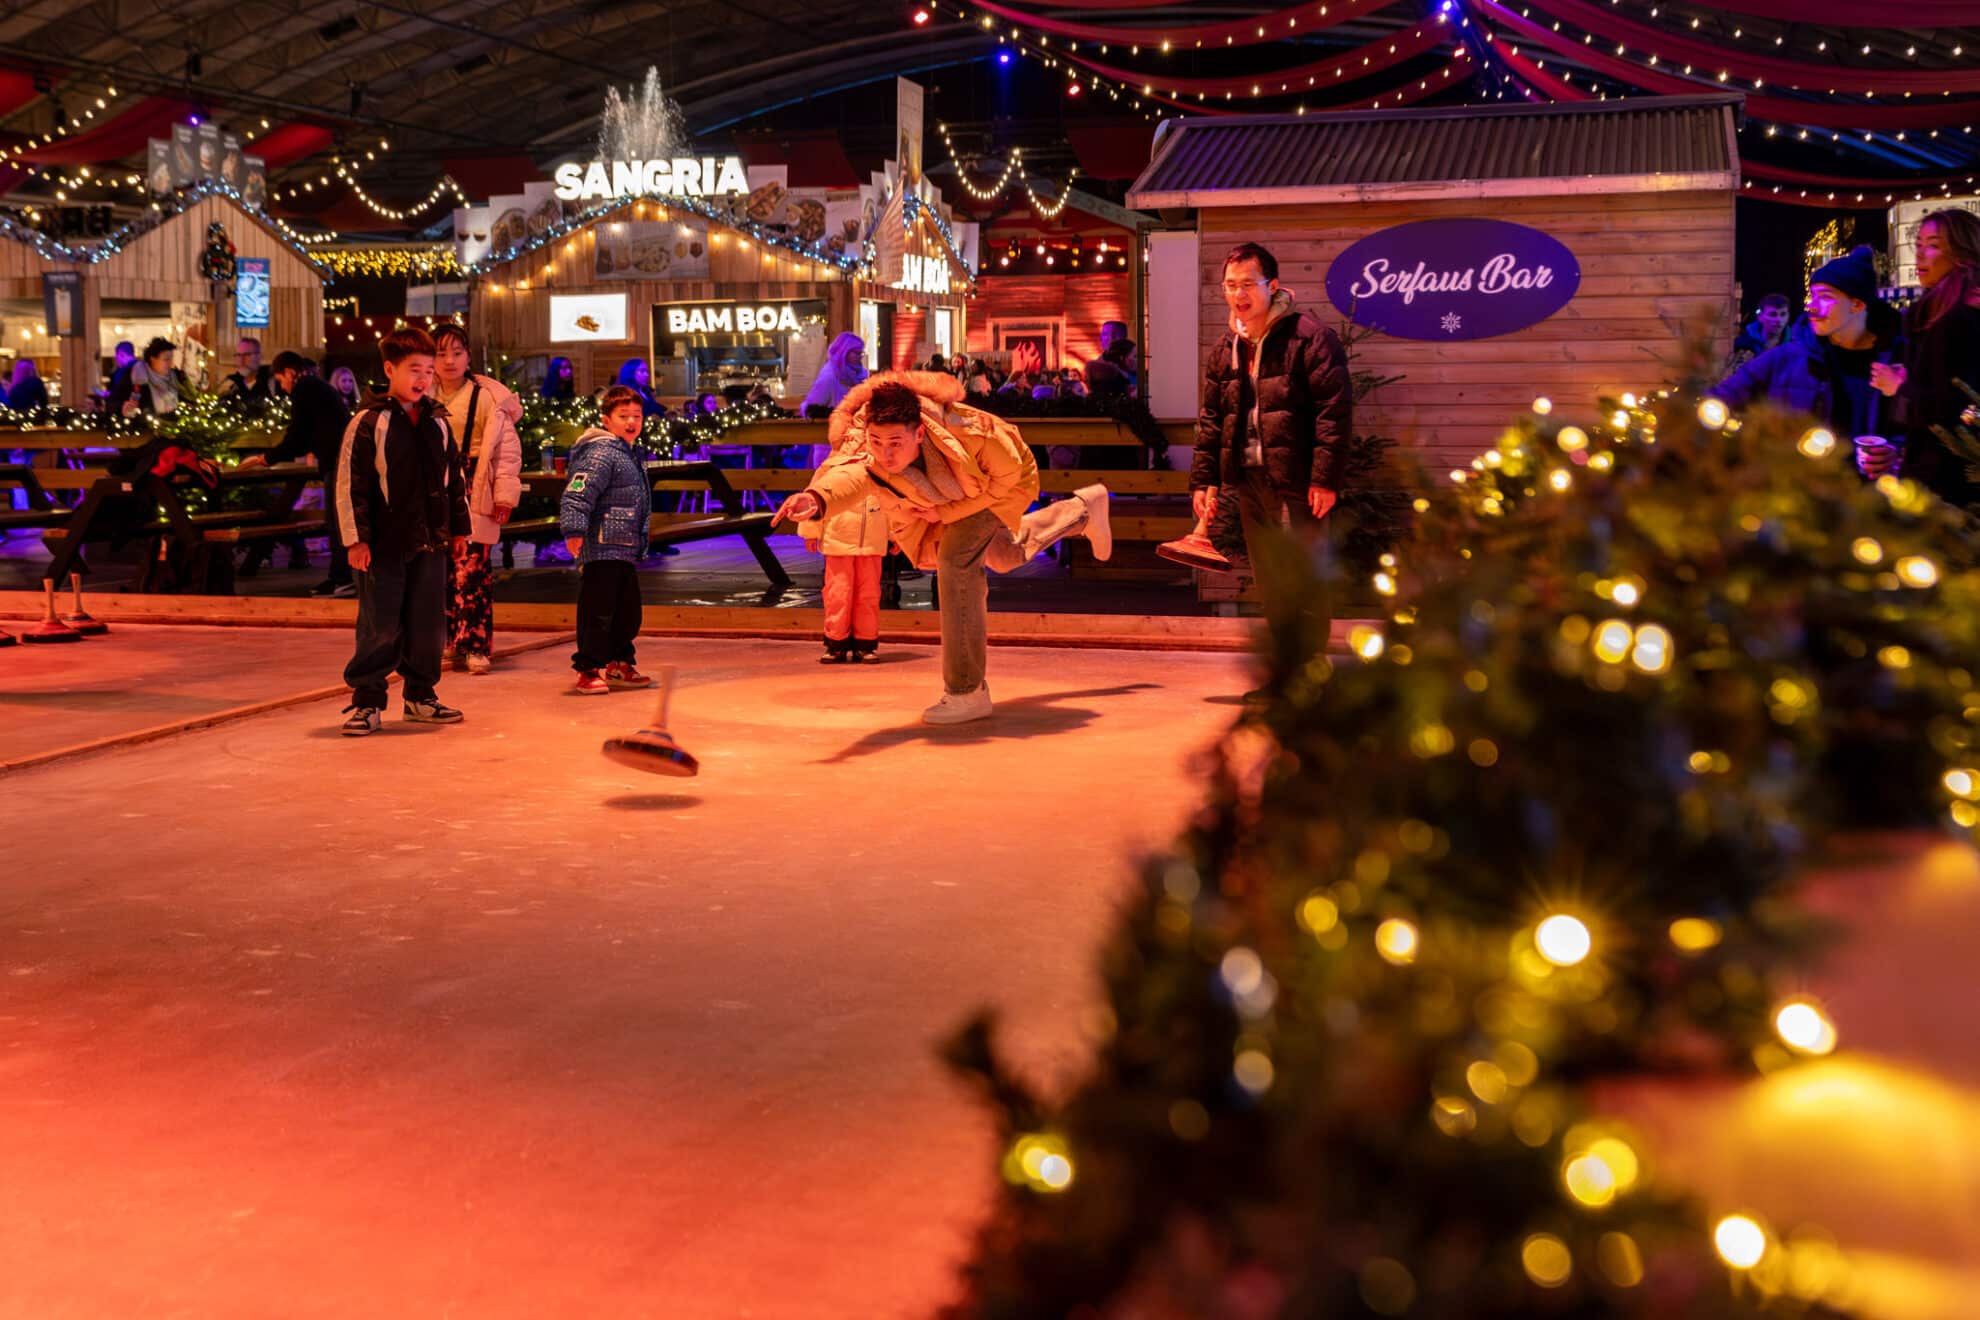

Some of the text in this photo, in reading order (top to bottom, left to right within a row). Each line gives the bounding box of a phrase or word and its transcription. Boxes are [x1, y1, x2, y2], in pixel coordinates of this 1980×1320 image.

[554, 156, 750, 200] SANGRIA
[892, 252, 922, 292] AM
[1351, 253, 1554, 305] Serfaus Bar
